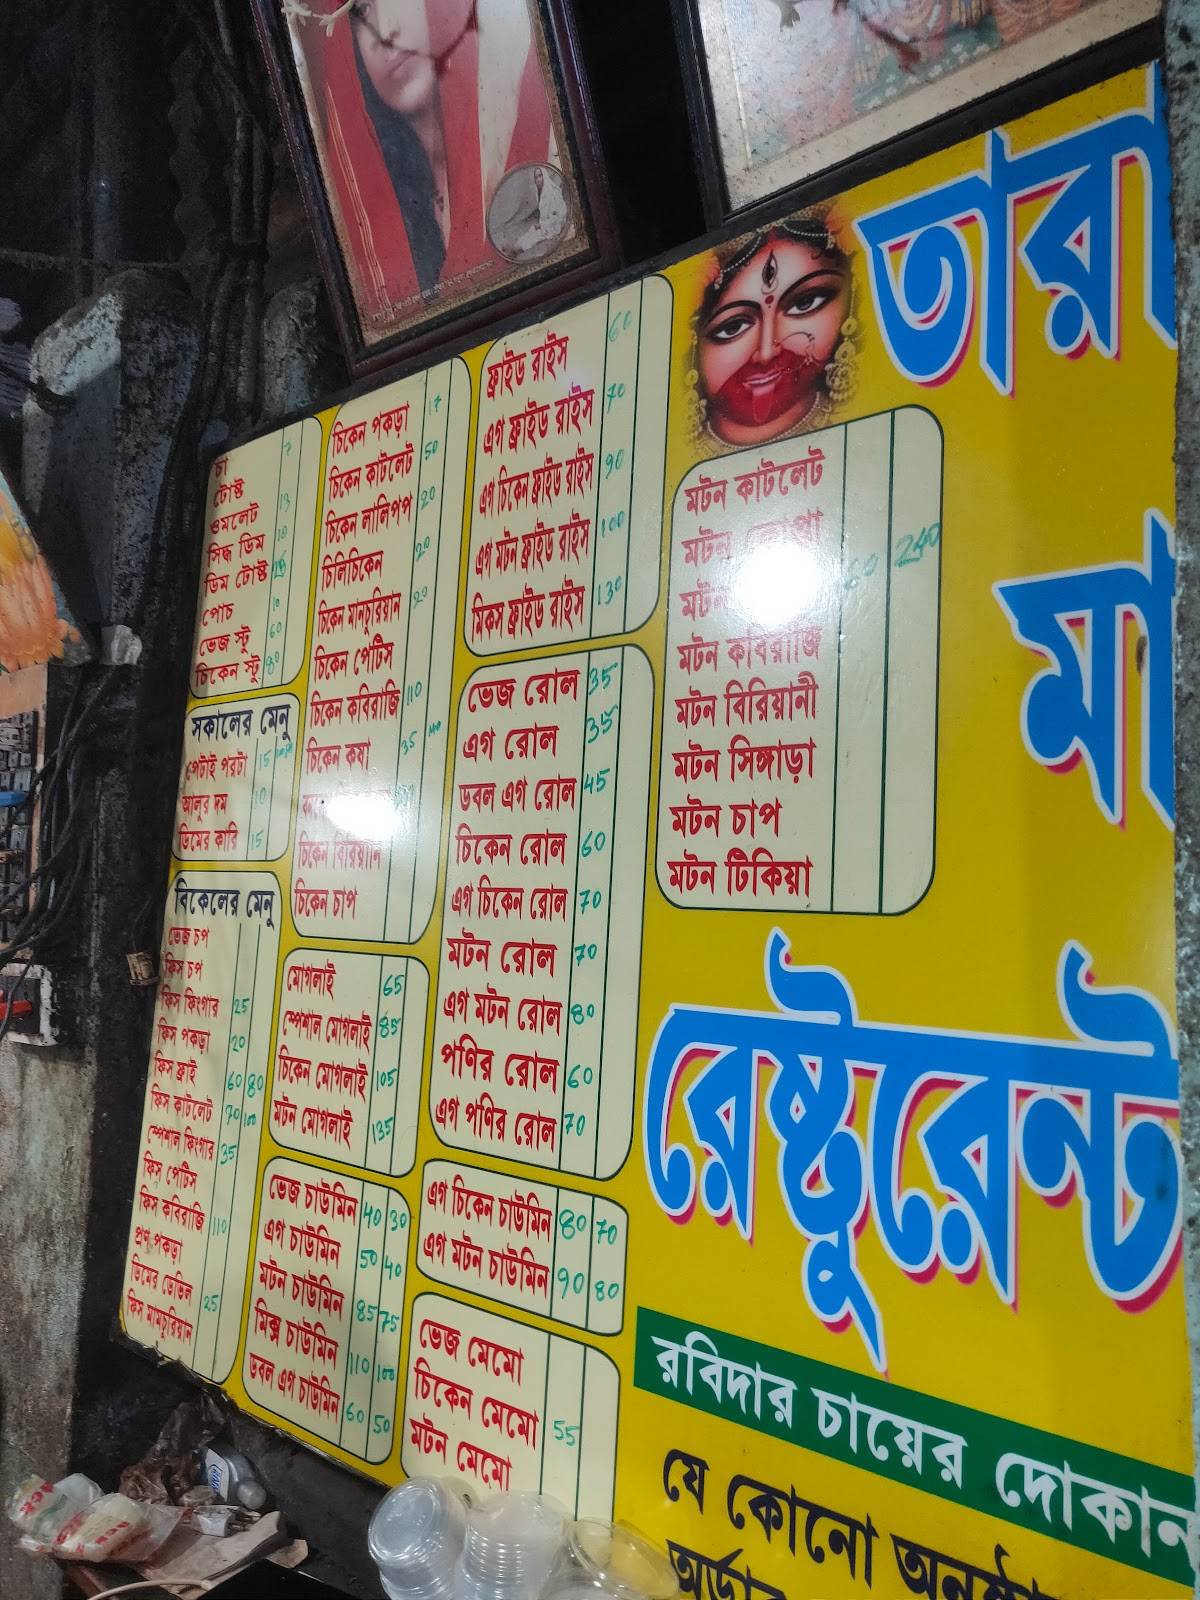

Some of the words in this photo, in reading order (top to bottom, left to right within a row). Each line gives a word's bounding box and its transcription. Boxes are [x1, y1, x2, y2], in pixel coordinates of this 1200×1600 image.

[851, 58, 1178, 400] তারা
[531, 329, 569, 382] রাইস
[332, 421, 367, 458] চিকেন
[372, 400, 410, 440] পকড়া
[483, 415, 505, 458] এগ
[554, 381, 595, 437] রাইস
[329, 466, 362, 502] চিকেন
[365, 441, 415, 488] কাটলেট
[480, 476, 495, 519] এগ
[498, 465, 530, 516] চিকেন
[566, 442, 594, 498] রাইস
[684, 474, 728, 517] মটন
[734, 446, 826, 504] কাটলেট
[209, 502, 260, 534] ওমলেট
[325, 510, 358, 548] চিকেন
[238, 532, 266, 559] ডিম
[202, 603, 234, 626] পোচ
[200, 634, 230, 656] ভেজ
[314, 644, 349, 683] চিকেন
[194, 662, 240, 688] চিকেন
[468, 678, 516, 712] ভেজ
[525, 667, 580, 706] রোল
[589, 662, 618, 695] 35
[991, 506, 1176, 832] মা
[310, 690, 343, 730] চিকেন
[346, 678, 400, 724] কবিরাজি
[675, 686, 717, 729] মটন
[724, 671, 819, 727] বিরিয়ানী
[192, 708, 254, 743] সকালের
[260, 704, 291, 742] মেনু
[463, 727, 496, 763] এগ
[505, 722, 560, 760] রোল
[587, 704, 618, 743] 35
[306, 736, 341, 776] চিকেন
[672, 740, 721, 784] মটন
[728, 734, 817, 784] সিঙ্গাড়া
[459, 782, 497, 814] ডবল
[502, 776, 528, 813] এগ
[535, 773, 577, 812] রোল
[584, 768, 610, 794] 45
[669, 794, 722, 838] মটন
[729, 798, 783, 838] চাপ
[455, 822, 513, 866] চিকেন
[520, 828, 568, 867] রোল
[581, 831, 606, 857] 60
[667, 849, 717, 895] মটন
[724, 847, 813, 897] টিকিয়া
[174, 878, 240, 918] বিকেলের
[246, 890, 275, 932] মেনু
[294, 877, 329, 919] চিকেন
[332, 886, 358, 920] চাপ
[452, 881, 473, 918] এগ
[478, 874, 525, 920] চিকেন
[530, 883, 568, 923] রোল
[579, 889, 602, 915] 70
[447, 927, 491, 973] মটন
[501, 937, 558, 978] রোল
[575, 943, 597, 967] 70
[287, 959, 336, 1000] মোগলাই
[383, 974, 404, 997] 65
[379, 1015, 401, 1039] 85
[443, 986, 470, 1024] এগ
[474, 982, 511, 1030] মটন
[518, 994, 563, 1037] রোল
[570, 1003, 595, 1025] 80
[326, 1010, 372, 1054] মোগলাই
[278, 1044, 312, 1086] চিকেন
[316, 1058, 369, 1103] মোগলাই
[376, 1068, 398, 1092] 105
[441, 1033, 495, 1084] পণির
[505, 1050, 560, 1094] রোল
[567, 1064, 593, 1089] 60
[273, 1092, 298, 1133] মটন
[301, 1105, 354, 1150] মোগলাই
[371, 1117, 394, 1145] 135
[435, 1096, 460, 1132] এগ
[465, 1092, 508, 1143] পণির
[514, 1109, 558, 1153] রোল
[564, 1113, 586, 1137] 70
[269, 1174, 301, 1208] ভেজ
[304, 1178, 359, 1226] চাউমিন
[363, 1202, 382, 1229] 40
[389, 1209, 408, 1232] 30
[427, 1178, 448, 1214] এগ
[452, 1173, 495, 1227] চিকেন
[498, 1189, 552, 1243] চাউমিন
[264, 1218, 286, 1249] এগ
[289, 1220, 342, 1270] চাউমিন
[559, 1208, 587, 1240] 80
[596, 1219, 618, 1245] 70
[360, 1249, 378, 1269] 50
[384, 1256, 401, 1280] 40
[424, 1231, 447, 1265] এগ
[451, 1230, 484, 1279] মটন
[488, 1243, 550, 1299] চাউমিন
[557, 1267, 585, 1300] 90
[595, 1280, 620, 1302] 80
[259, 1255, 288, 1298] মটন
[292, 1270, 345, 1321] চাউমিন
[357, 1299, 377, 1322] 85
[379, 1310, 400, 1333] 75
[419, 1318, 461, 1361] ভেজ
[467, 1336, 525, 1387] মেমো
[249, 1352, 275, 1390] ডবল
[278, 1368, 296, 1399] এগ
[299, 1371, 341, 1424] চাউমিন
[414, 1357, 474, 1421] চিকেন
[481, 1396, 539, 1450] মেমো
[346, 1402, 365, 1423] 60
[373, 1414, 390, 1434] 50
[553, 1420, 580, 1446] 55
[409, 1412, 448, 1465] মটন
[456, 1441, 513, 1491] মেমো
[651, 1331, 798, 1429] রবিদার
[810, 1387, 968, 1490] চায়ের
[995, 1452, 1195, 1567] দোকান
[663, 1449, 710, 1515] যে
[727, 1474, 880, 1590] কোনো
